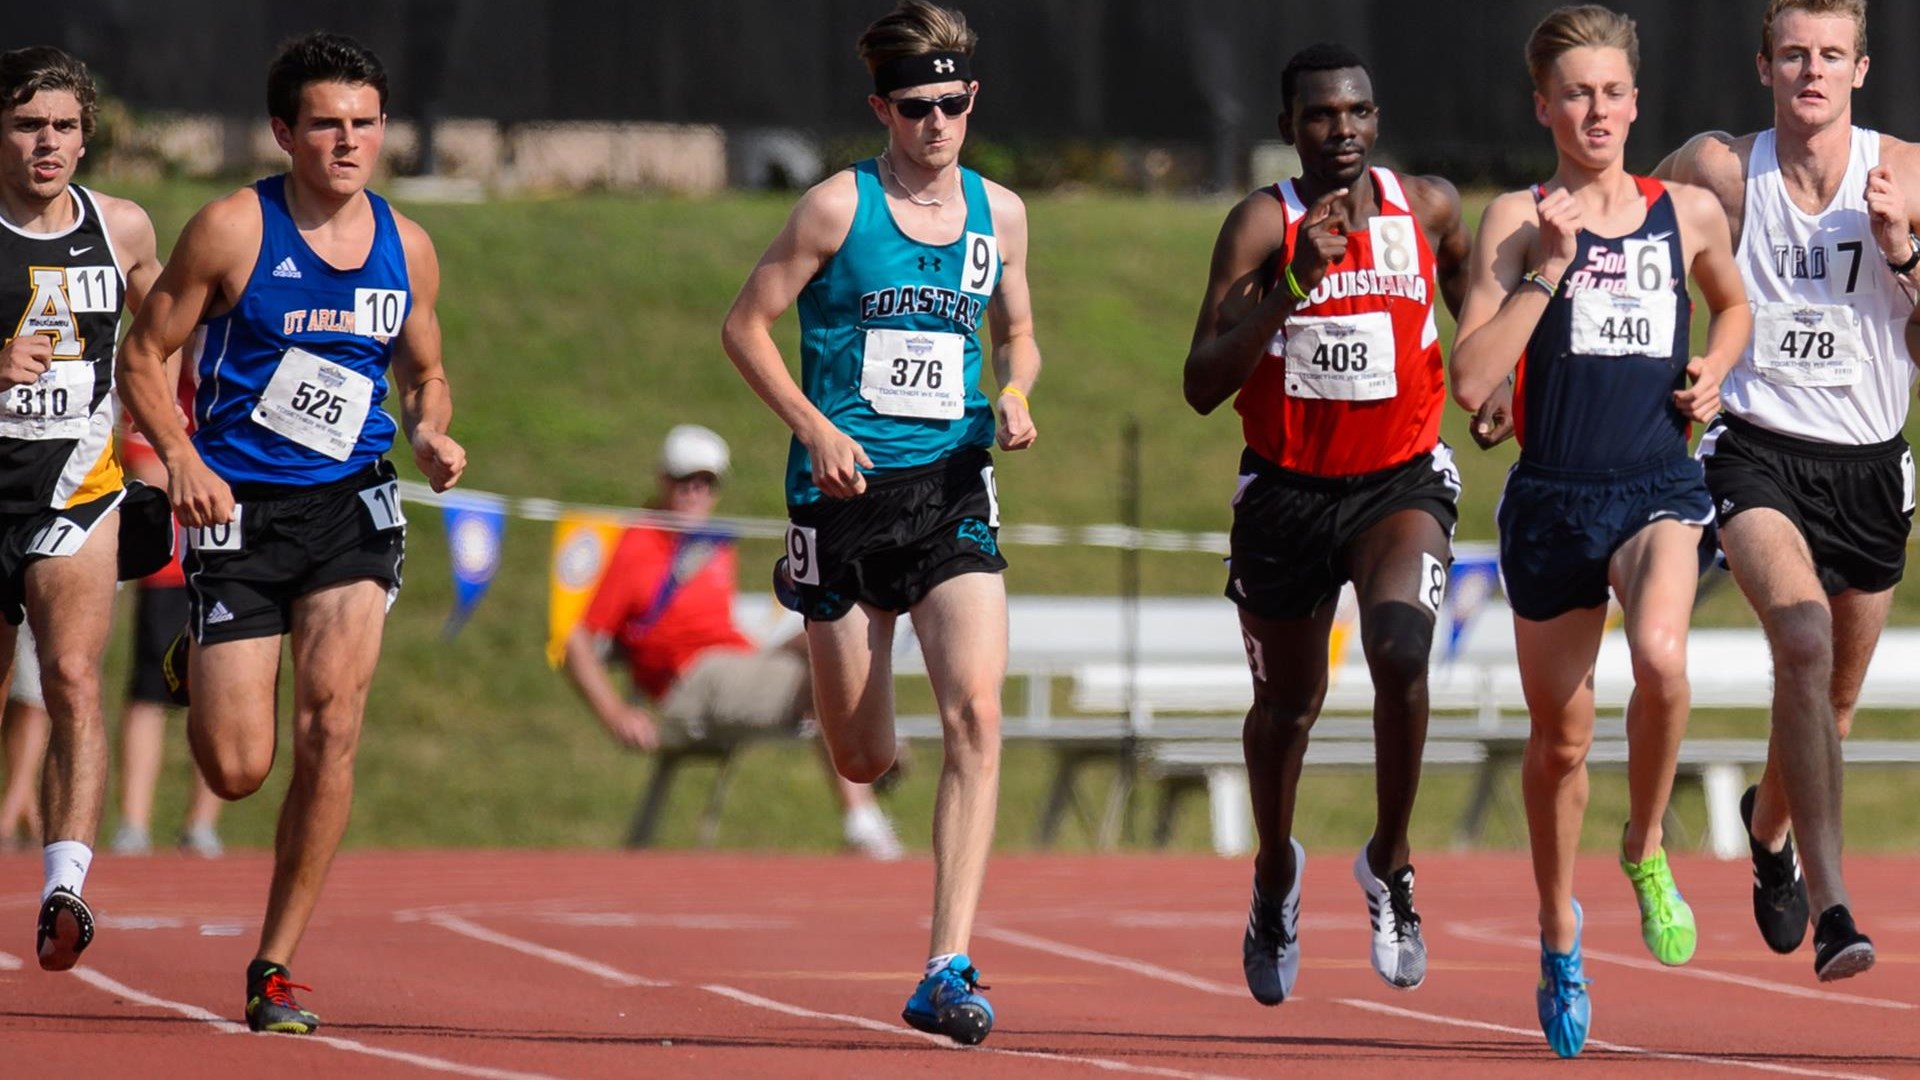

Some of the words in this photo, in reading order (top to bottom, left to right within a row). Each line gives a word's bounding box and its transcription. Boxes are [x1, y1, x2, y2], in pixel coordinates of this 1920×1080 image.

[970, 237, 990, 290] 9
[1379, 220, 1411, 272] 8
[1774, 245, 1829, 279] TRO
[1836, 240, 1863, 293] 7
[77, 269, 108, 308] 11
[1636, 244, 1661, 291] 6
[5, 266, 85, 360] A
[284, 310, 307, 335] UT
[366, 292, 398, 333] 10
[860, 285, 981, 332] COASTAL
[1600, 317, 1650, 346] 440
[1780, 330, 1834, 359] 478
[891, 358, 943, 389] 376
[1312, 342, 1368, 372] 403
[16, 388, 68, 416] 310
[291, 381, 347, 425] 525
[791, 528, 810, 578] 9
[1429, 563, 1444, 610] 8
